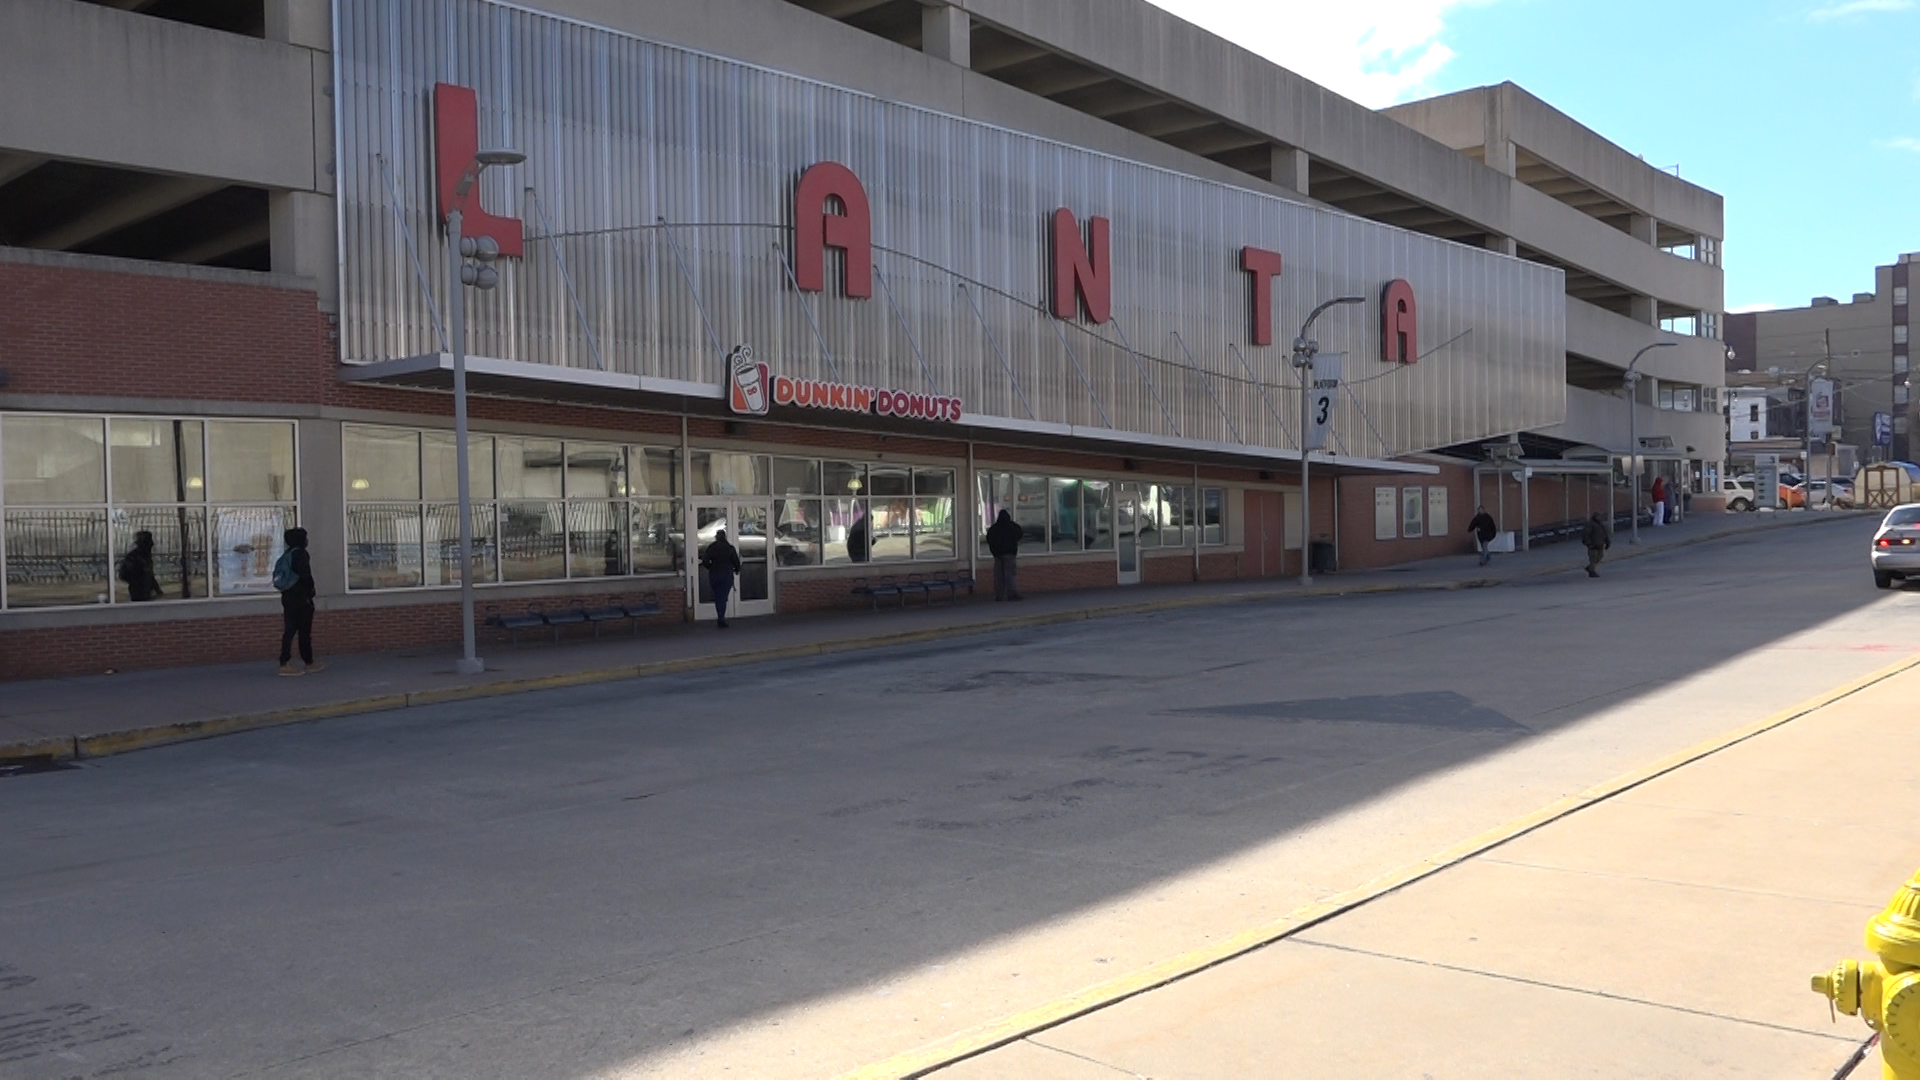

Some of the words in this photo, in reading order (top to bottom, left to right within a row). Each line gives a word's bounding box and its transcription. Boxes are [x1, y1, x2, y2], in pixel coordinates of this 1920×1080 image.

[775, 377, 875, 411] DUNKIN'
[876, 390, 961, 421] DONUTS
[1317, 396, 1329, 425] 3
